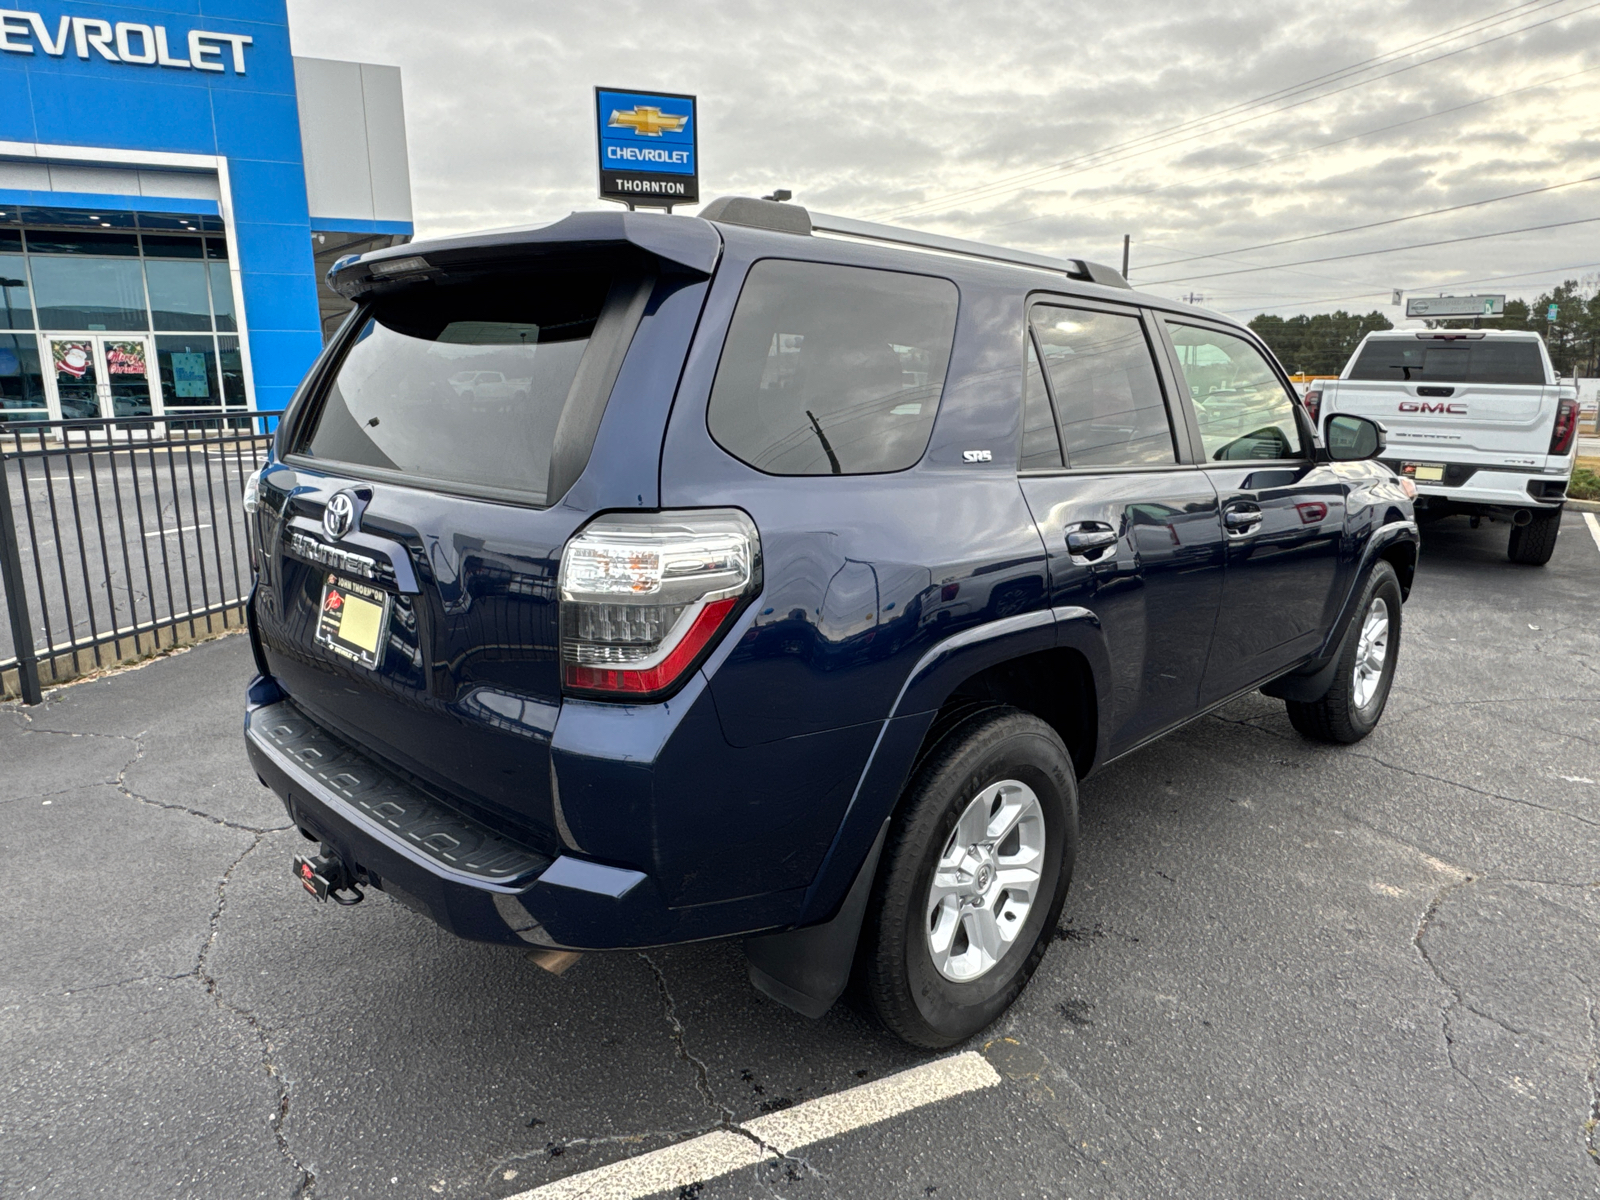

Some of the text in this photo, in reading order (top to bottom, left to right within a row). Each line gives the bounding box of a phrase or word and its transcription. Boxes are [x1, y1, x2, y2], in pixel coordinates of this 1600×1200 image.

[0, 9, 253, 74] EVROLET
[607, 146, 689, 163] CHEVROLET
[616, 179, 685, 194] THORNTON
[1398, 401, 1468, 414] GMC
[963, 449, 992, 464] SR5
[337, 577, 352, 590] JOHN
